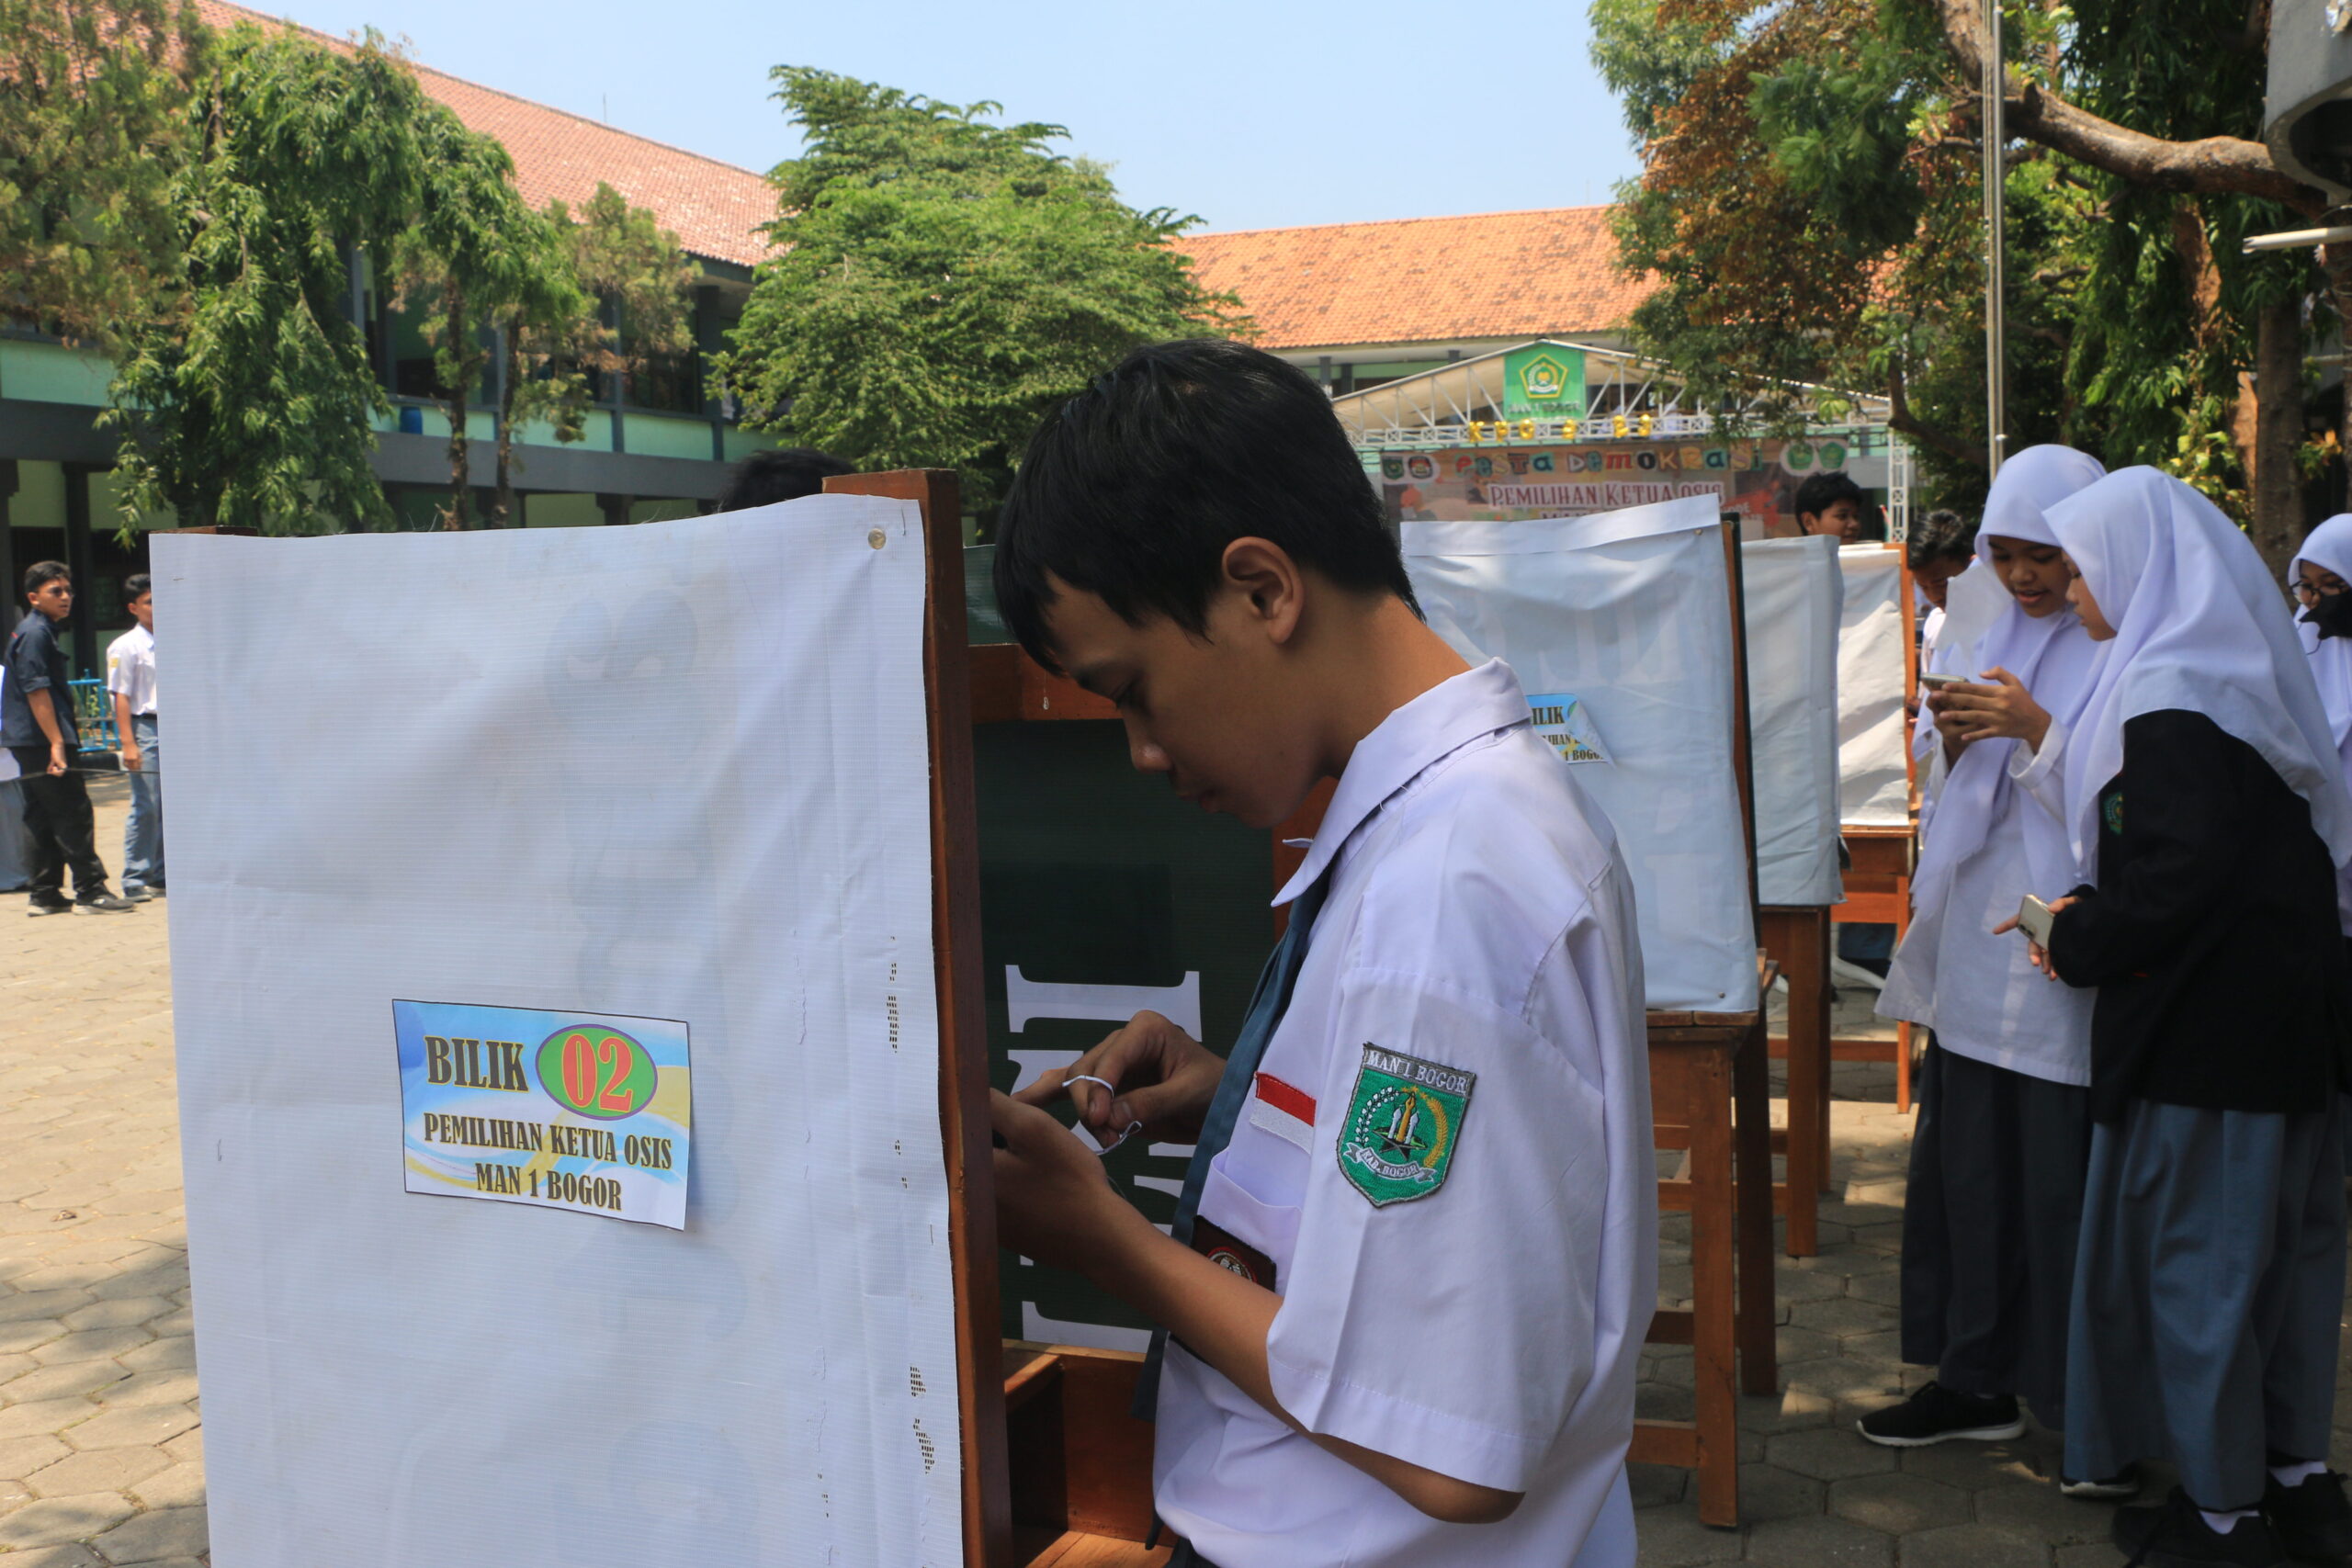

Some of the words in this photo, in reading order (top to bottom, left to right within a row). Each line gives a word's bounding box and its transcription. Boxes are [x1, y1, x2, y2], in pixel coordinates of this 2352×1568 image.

[1489, 485, 1598, 506] PEMILIHAN
[1605, 483, 1673, 505] KETUA
[1531, 705, 1565, 726] ILIK
[424, 1035, 528, 1092] BILIK
[561, 1033, 634, 1112] 02
[1367, 1050, 1401, 1074] MAN
[1415, 1066, 1467, 1095] BOGOR
[424, 1112, 542, 1152] PEMILIHAN
[549, 1124, 617, 1162] KETUA
[624, 1134, 672, 1170] OSIS
[475, 1163, 521, 1195] MAN
[528, 1168, 538, 1197] 1
[547, 1170, 622, 1211] BOGOR
[1382, 1164, 1419, 1178] BOGOR
